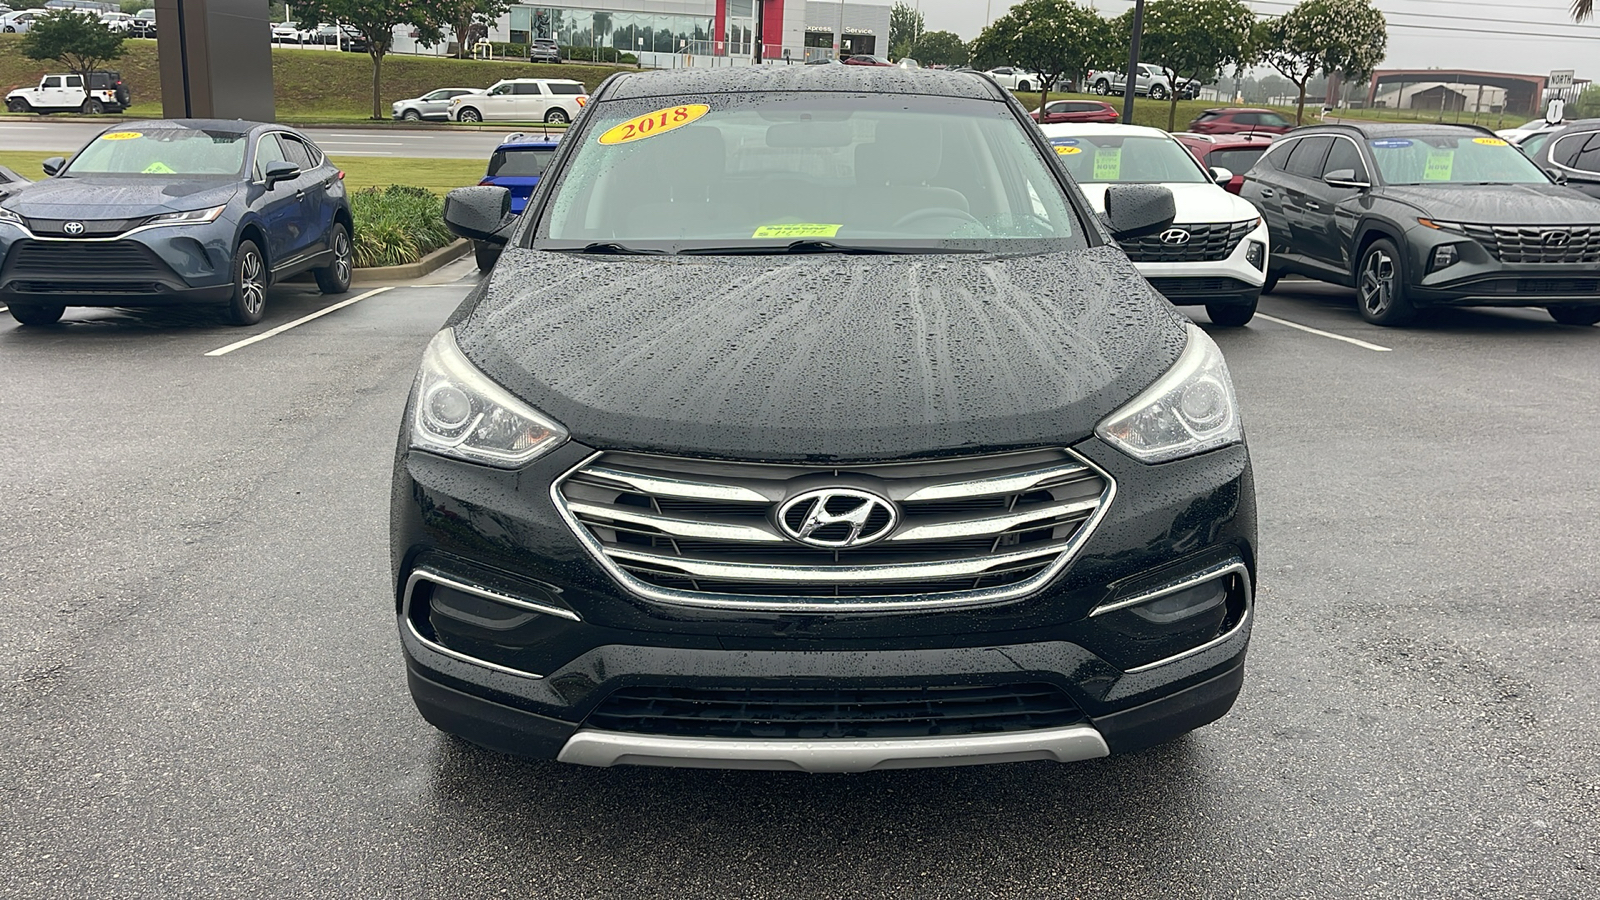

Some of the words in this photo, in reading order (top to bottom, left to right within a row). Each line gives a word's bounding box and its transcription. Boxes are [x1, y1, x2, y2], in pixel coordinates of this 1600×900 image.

[845, 26, 873, 34] Service
[1551, 74, 1572, 85] NORTH
[1553, 104, 1558, 118] 1
[621, 107, 688, 140] 2018
